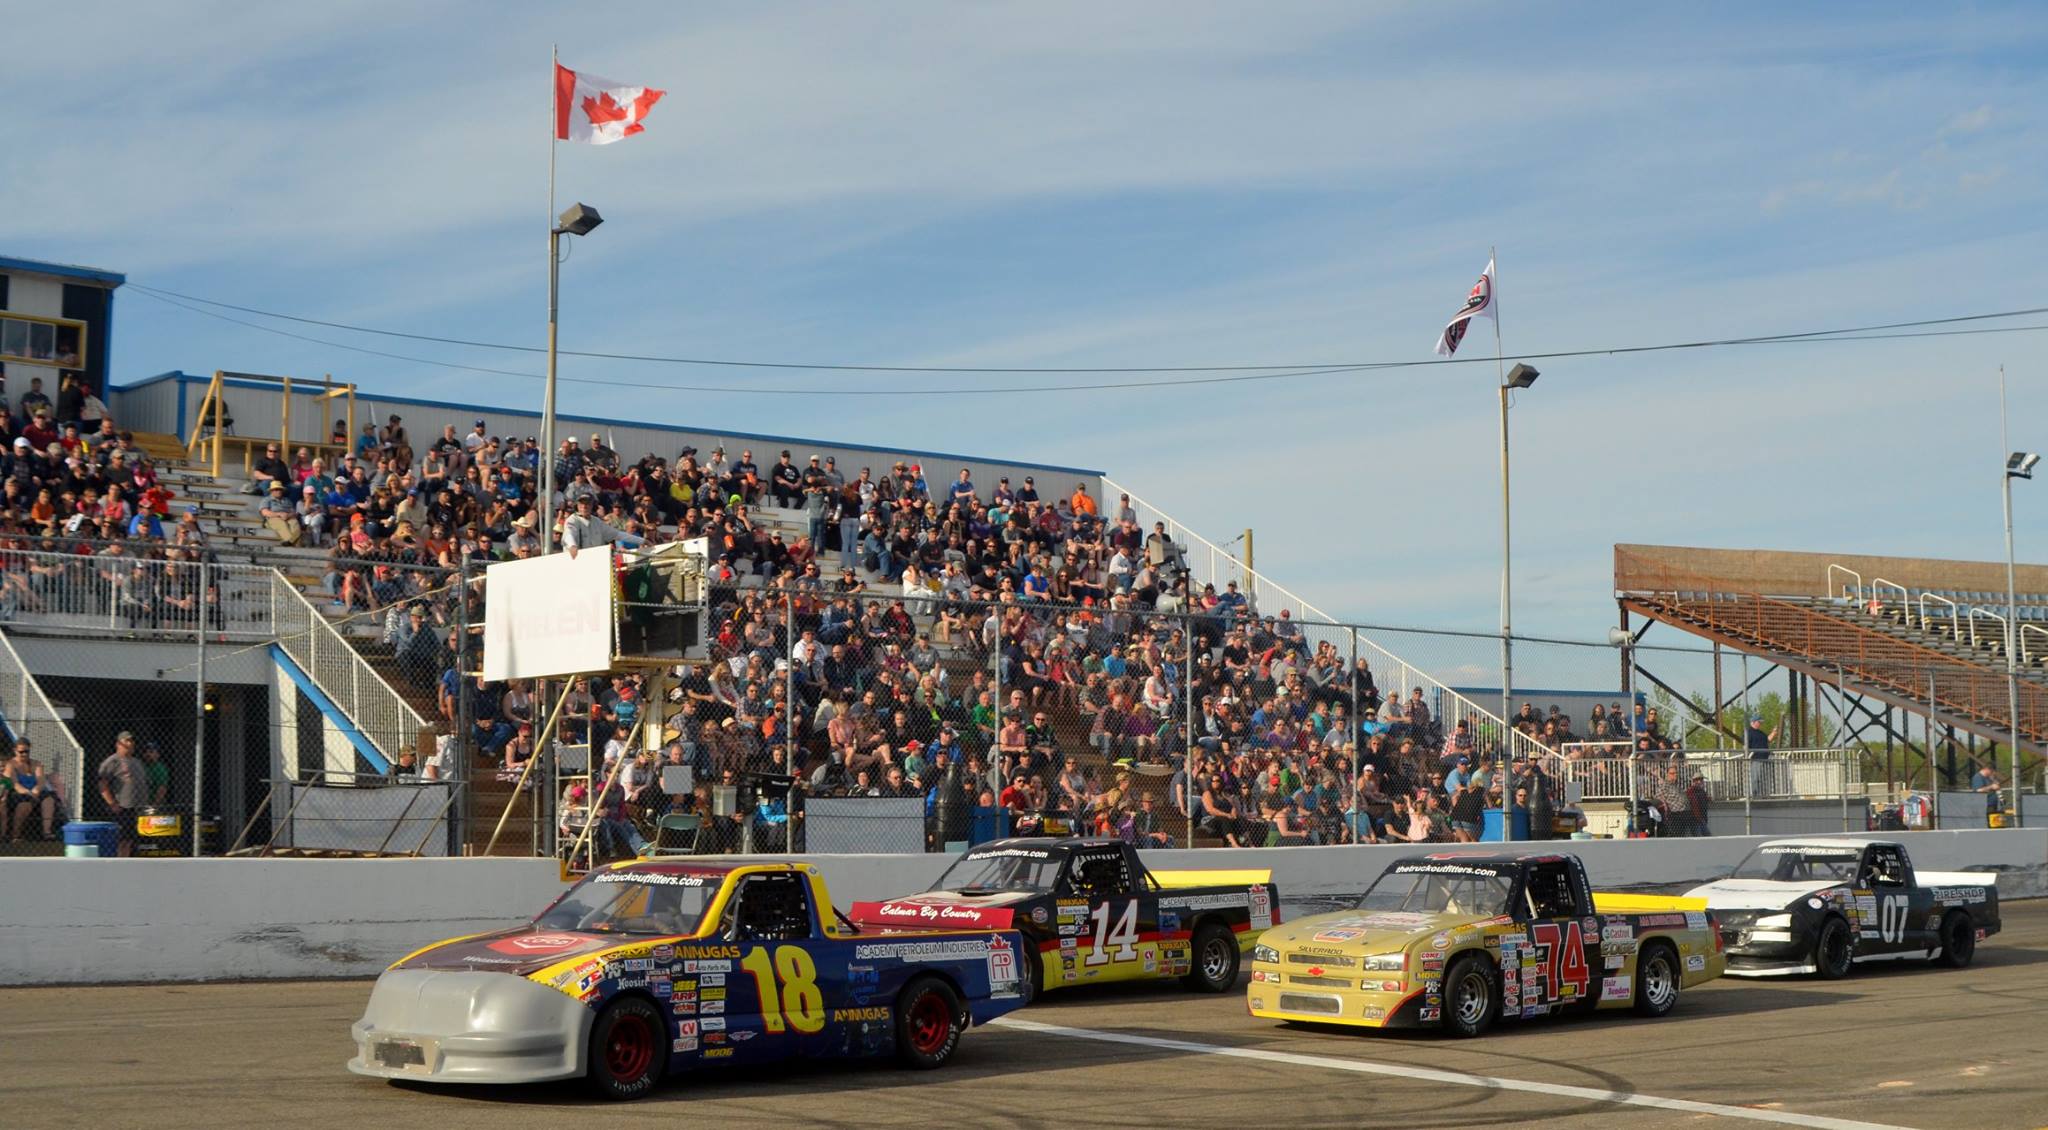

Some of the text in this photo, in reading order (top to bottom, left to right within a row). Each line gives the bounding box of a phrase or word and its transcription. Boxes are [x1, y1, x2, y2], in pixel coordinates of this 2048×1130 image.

[1395, 864, 1497, 877] thetruckoutfitters.com
[594, 872, 703, 888] thetruckoutfitters.com
[880, 904, 981, 921] Calmar Big Country
[1882, 895, 1909, 943] 07
[1084, 898, 1140, 967] 14
[857, 941, 986, 957] ACADEMY PETROLEUM INDUSTRIES
[1298, 945, 1344, 955] SILVERADO
[1532, 920, 1590, 1002] 74
[1535, 964, 1548, 976] 3M
[672, 991, 697, 1001] ARP
[740, 944, 826, 1035] 18
[682, 1022, 695, 1035] CV
[703, 1049, 734, 1058] MOOG
